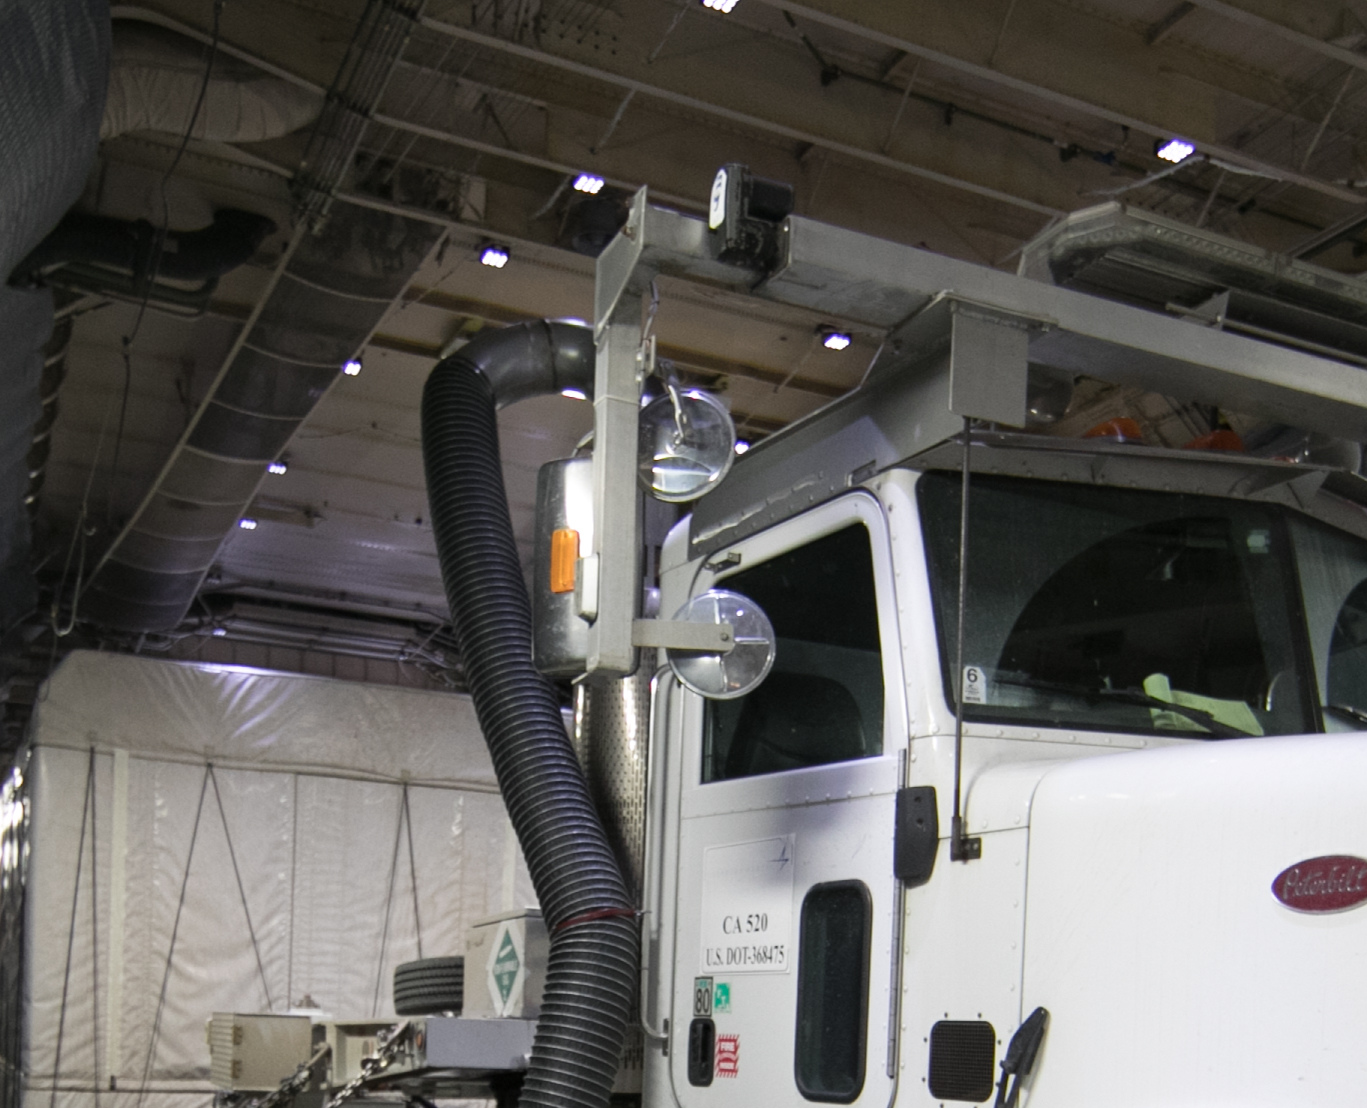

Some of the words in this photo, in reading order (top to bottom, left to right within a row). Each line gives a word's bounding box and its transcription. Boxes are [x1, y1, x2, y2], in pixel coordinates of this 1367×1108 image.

[967, 668, 978, 683] 6
[722, 915, 742, 935] CA
[746, 912, 768, 933] 520
[705, 947, 724, 967] U.S.
[726, 945, 785, 966] DOT-368475
[695, 987, 710, 1014] 80
